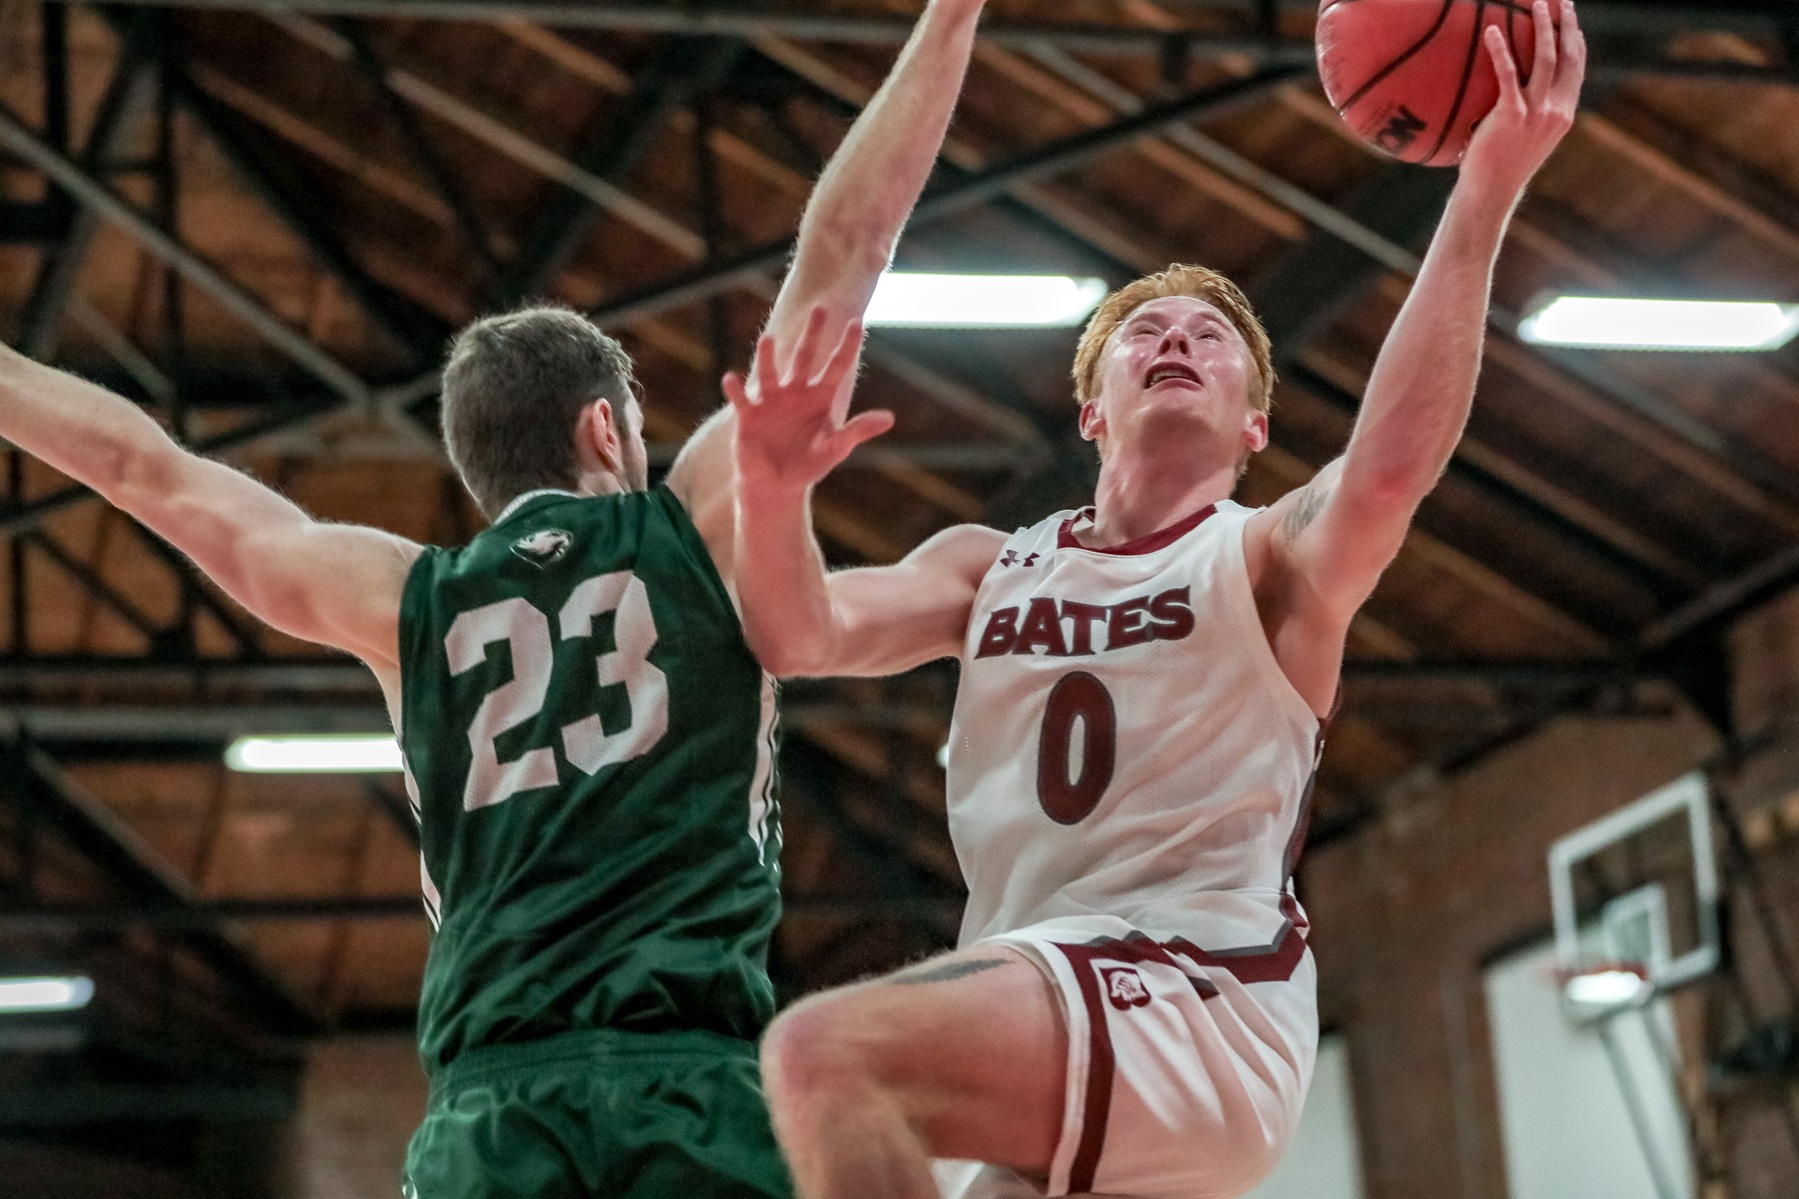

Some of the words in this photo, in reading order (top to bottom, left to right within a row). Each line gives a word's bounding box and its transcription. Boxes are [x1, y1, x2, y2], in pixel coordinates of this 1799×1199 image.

[444, 570, 669, 812] 23
[974, 584, 1195, 660] BATES
[1036, 671, 1117, 826] 0
